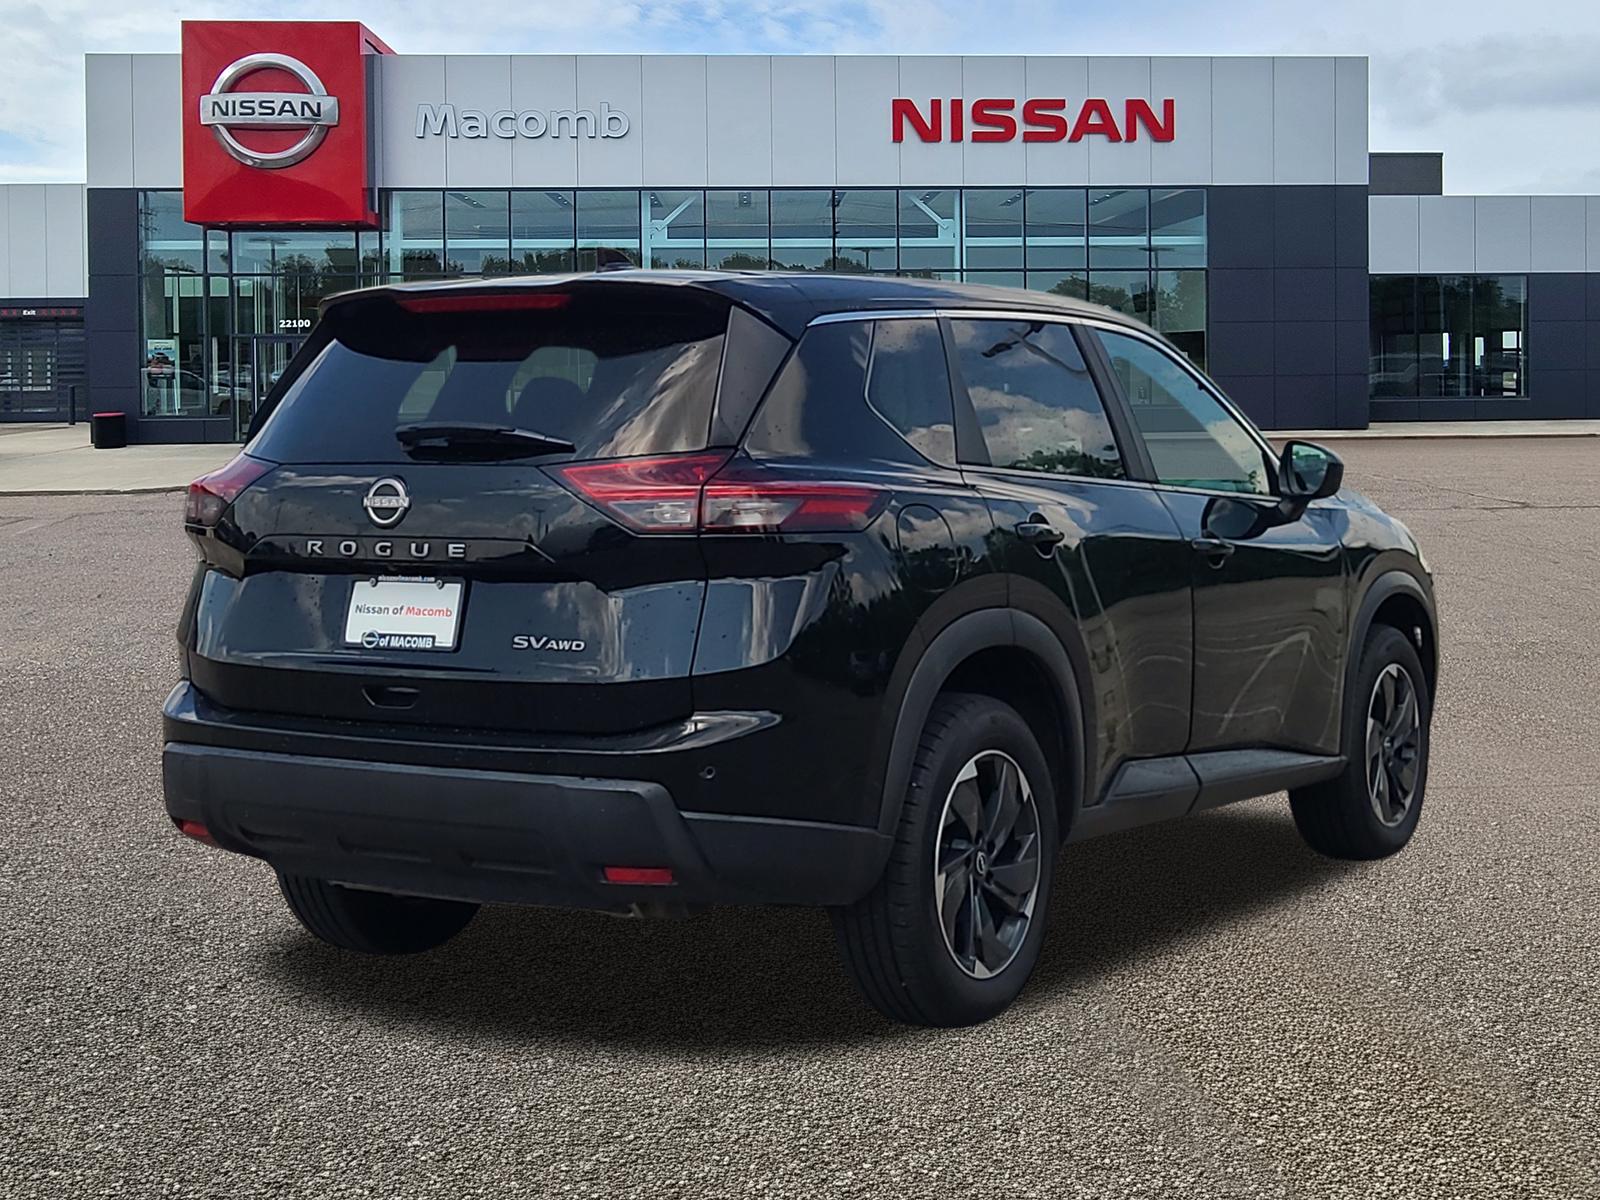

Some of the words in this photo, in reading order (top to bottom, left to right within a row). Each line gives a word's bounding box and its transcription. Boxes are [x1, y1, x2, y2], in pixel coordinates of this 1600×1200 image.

[211, 100, 322, 117] NISSAN
[415, 101, 630, 138] Macomb
[891, 98, 1175, 143] NISSAN
[279, 319, 311, 328] 22100
[363, 496, 410, 508] NISSAN
[306, 540, 466, 558] ROGUE
[355, 604, 390, 615] Nissan
[392, 605, 404, 616] of
[405, 606, 452, 617] Macomb
[379, 636, 389, 648] of
[390, 635, 433, 649] MACOMB
